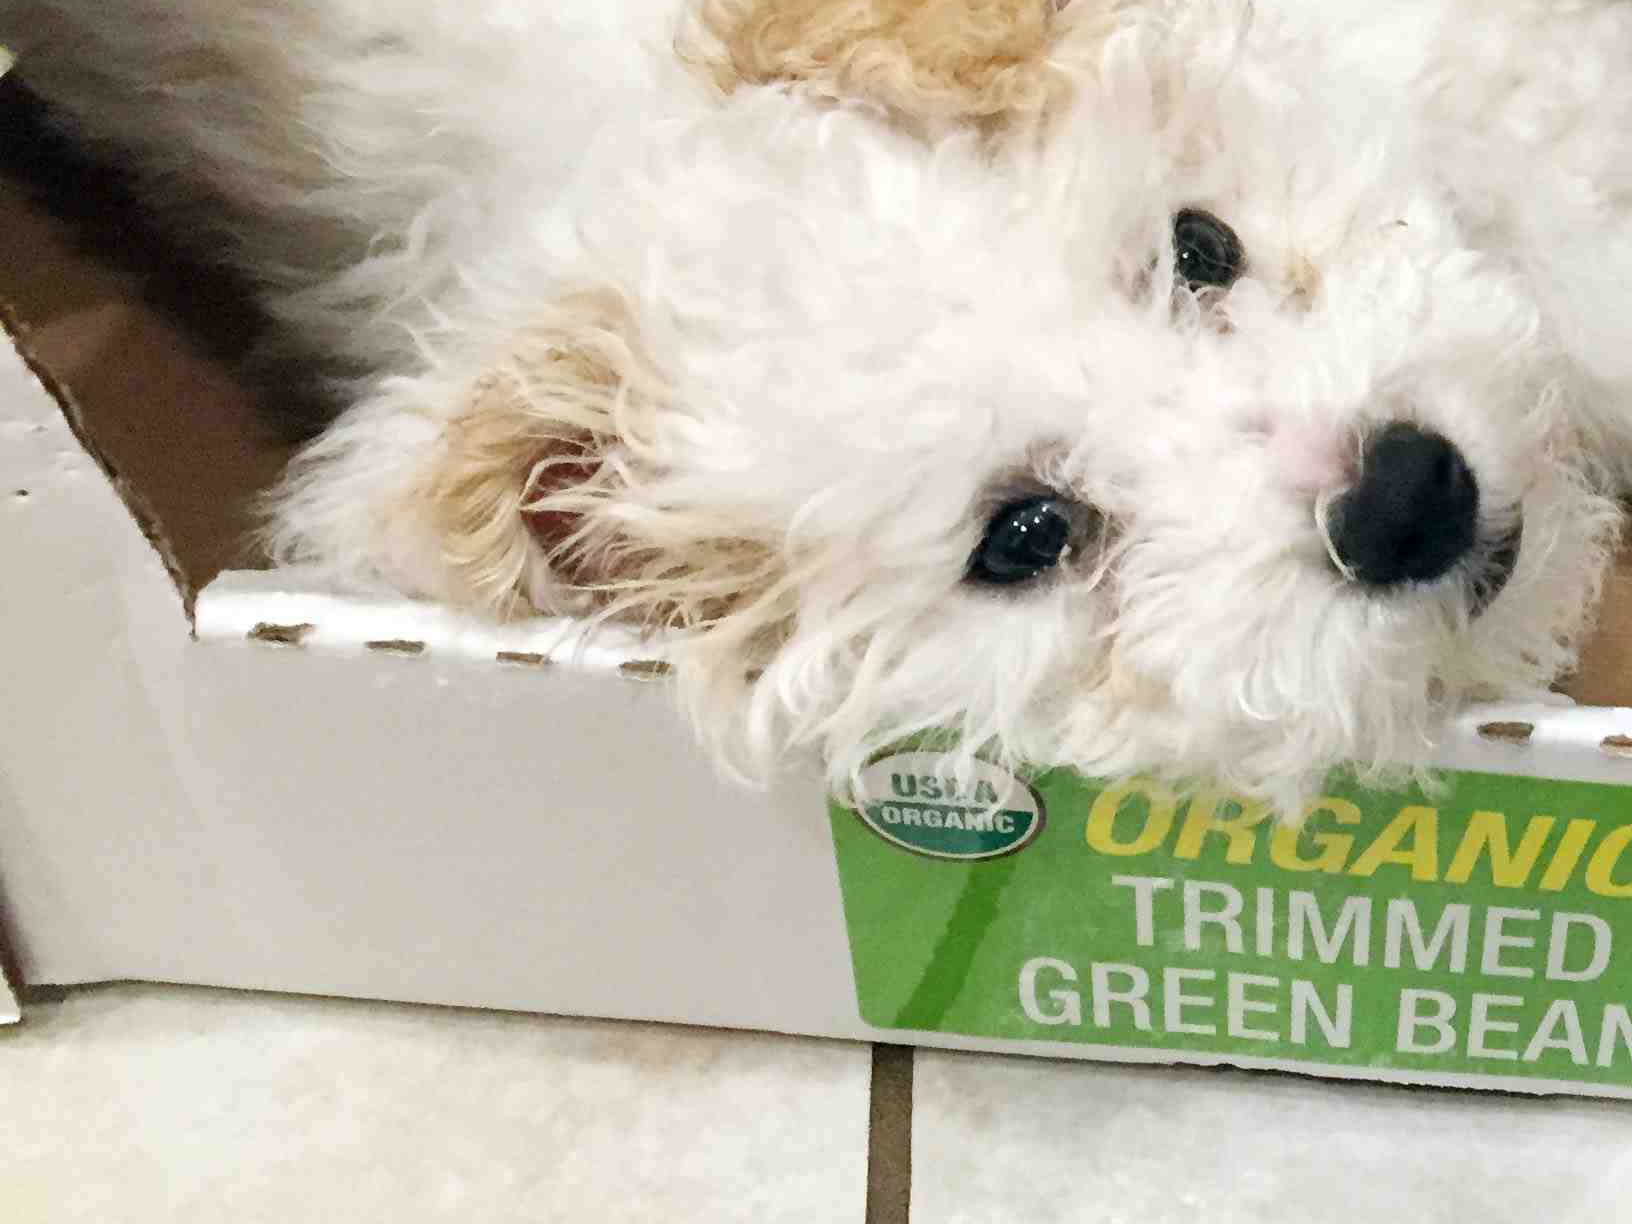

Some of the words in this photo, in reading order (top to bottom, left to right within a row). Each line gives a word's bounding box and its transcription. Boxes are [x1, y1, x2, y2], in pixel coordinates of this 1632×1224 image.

[881, 805, 1015, 834] ORGANIC
[1111, 874, 1613, 982] TRIMMED
[1018, 956, 1354, 1049] GREEN
